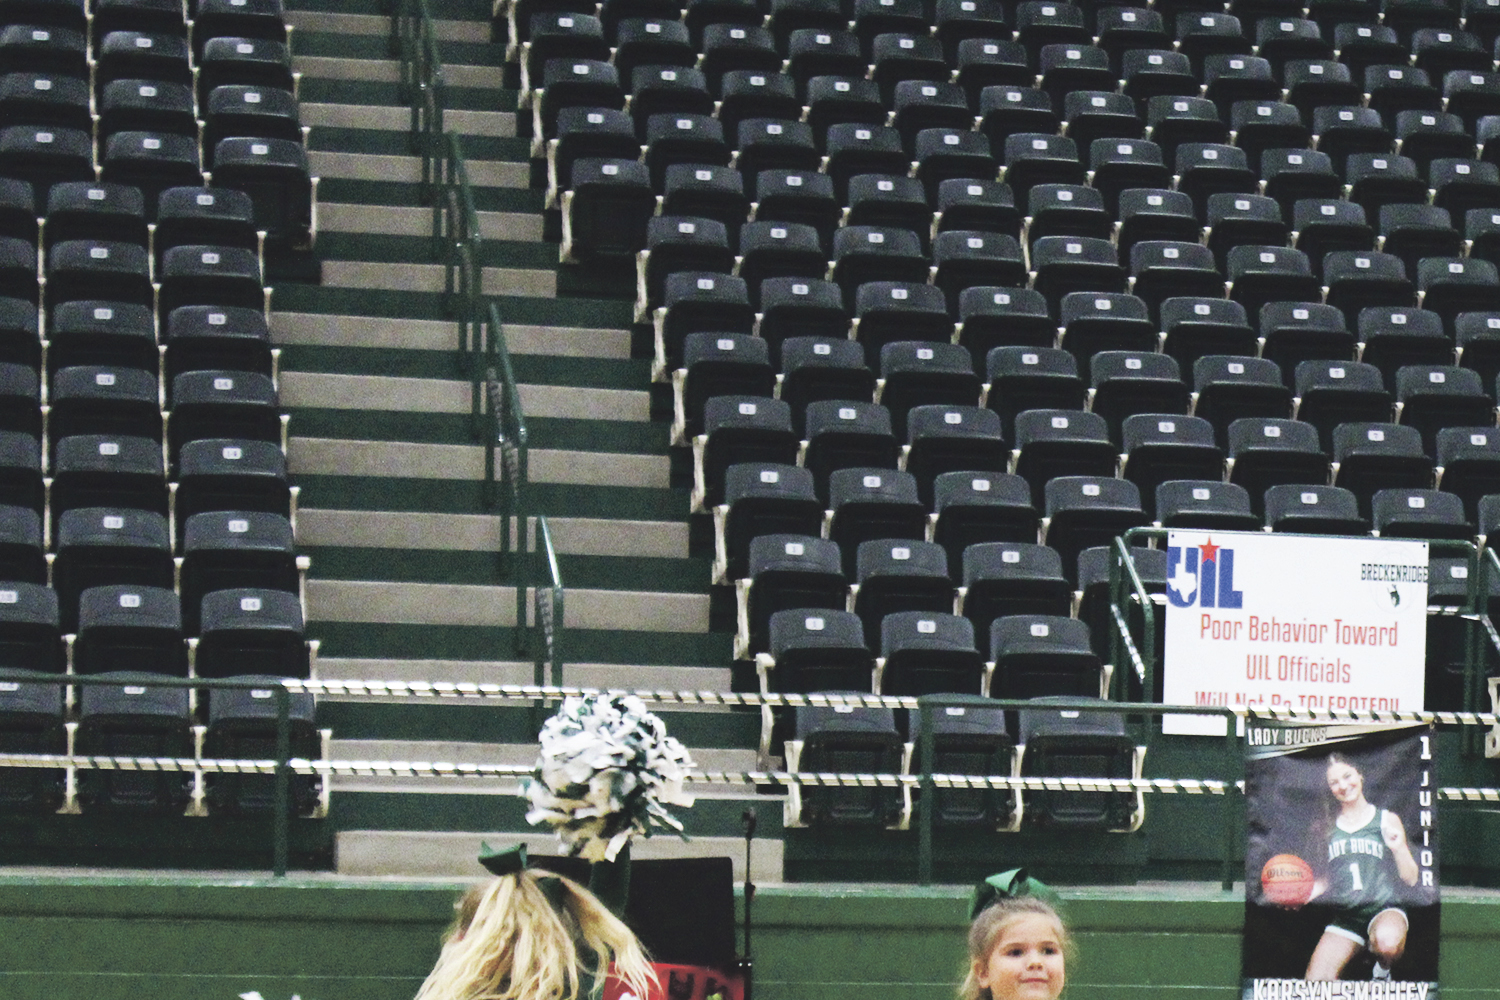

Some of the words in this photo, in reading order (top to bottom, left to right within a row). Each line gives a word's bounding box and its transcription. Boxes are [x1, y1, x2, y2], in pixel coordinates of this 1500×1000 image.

[1200, 614, 1242, 640] Poor
[1249, 616, 1328, 643] Behavior
[1334, 619, 1398, 646] Toward
[1246, 654, 1271, 680] UIL
[1278, 655, 1351, 683] Officials
[1247, 728, 1279, 746] LADY
[1284, 727, 1328, 745] BUCKS
[1420, 736, 1432, 760] 1
[1419, 770, 1434, 887] JUNIOR
[1349, 862, 1363, 891] 1
